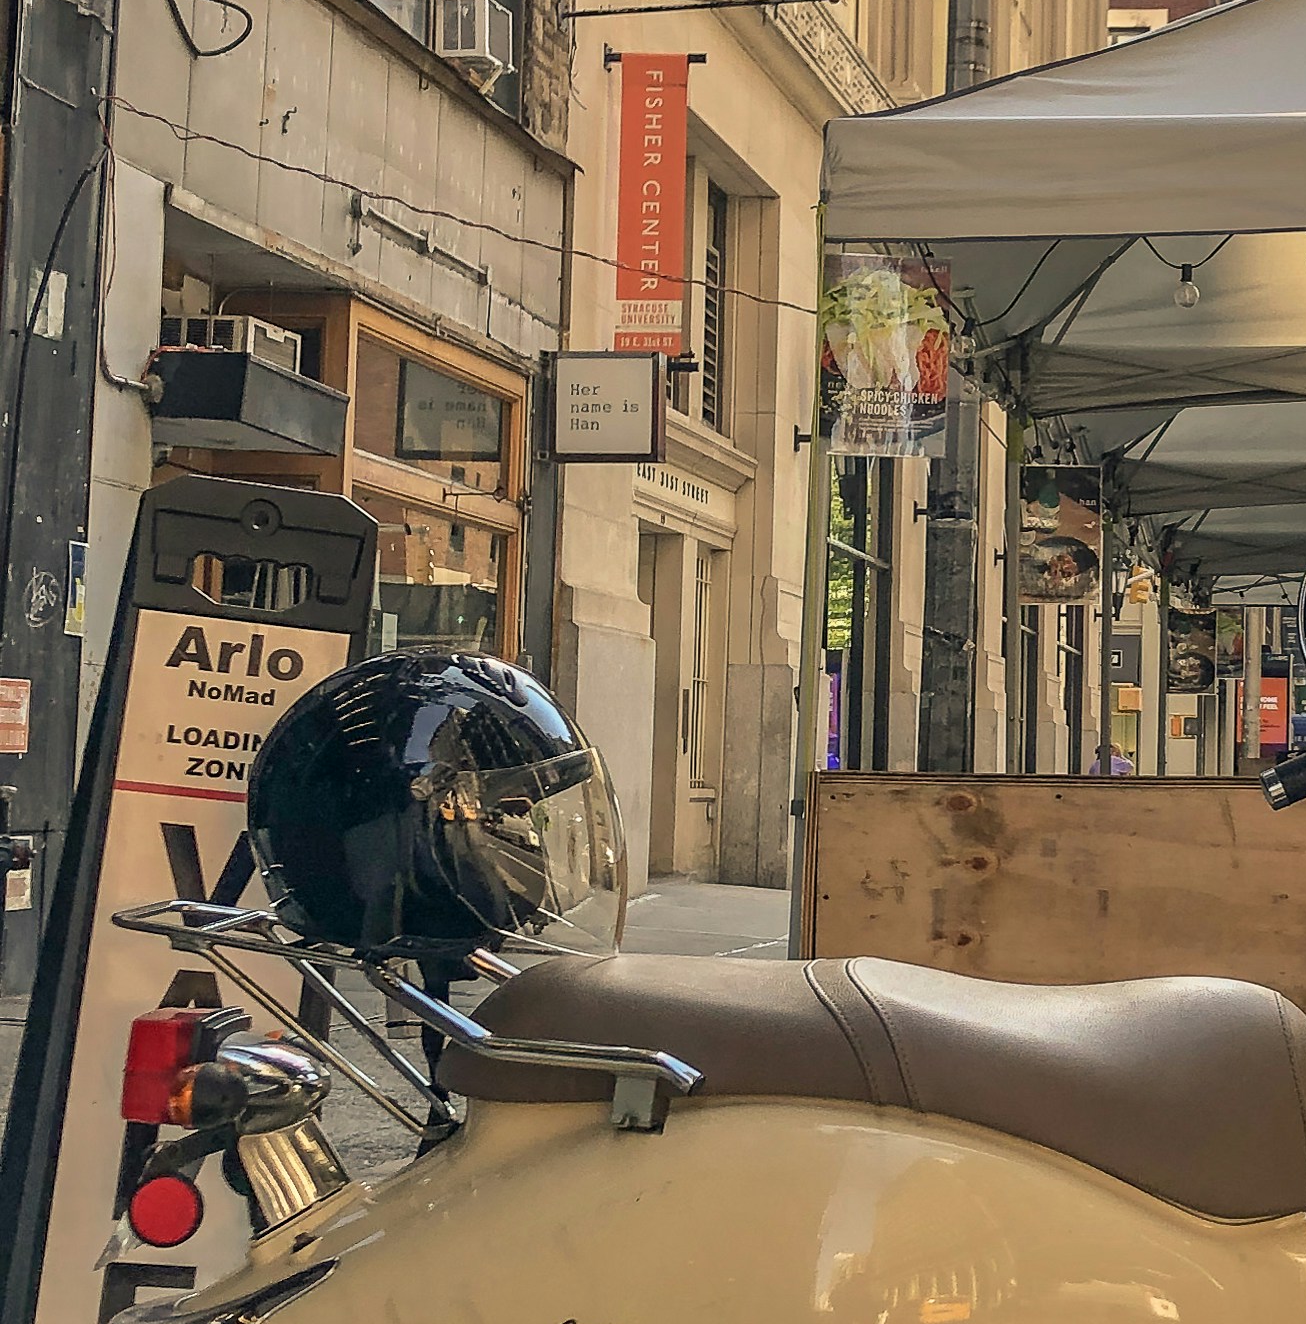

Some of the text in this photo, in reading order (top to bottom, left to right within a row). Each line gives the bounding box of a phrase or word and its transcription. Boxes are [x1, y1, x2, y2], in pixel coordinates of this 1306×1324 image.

[639, 70, 663, 292] FISHER CENTER
[621, 303, 668, 313] SYRACUSE
[621, 314, 675, 324] UNIVERSITY
[569, 383, 601, 396] Her
[860, 389, 939, 405] SPICY CHICKEN
[570, 399, 640, 413] name is
[860, 403, 907, 417] NOODLES
[569, 417, 601, 431] Han
[637, 462, 709, 505] EAST 31ST STREET
[165, 626, 304, 682] Arlo
[187, 679, 276, 706] NoMad
[166, 724, 264, 752] LOADIN
[185, 757, 250, 781] ZON
